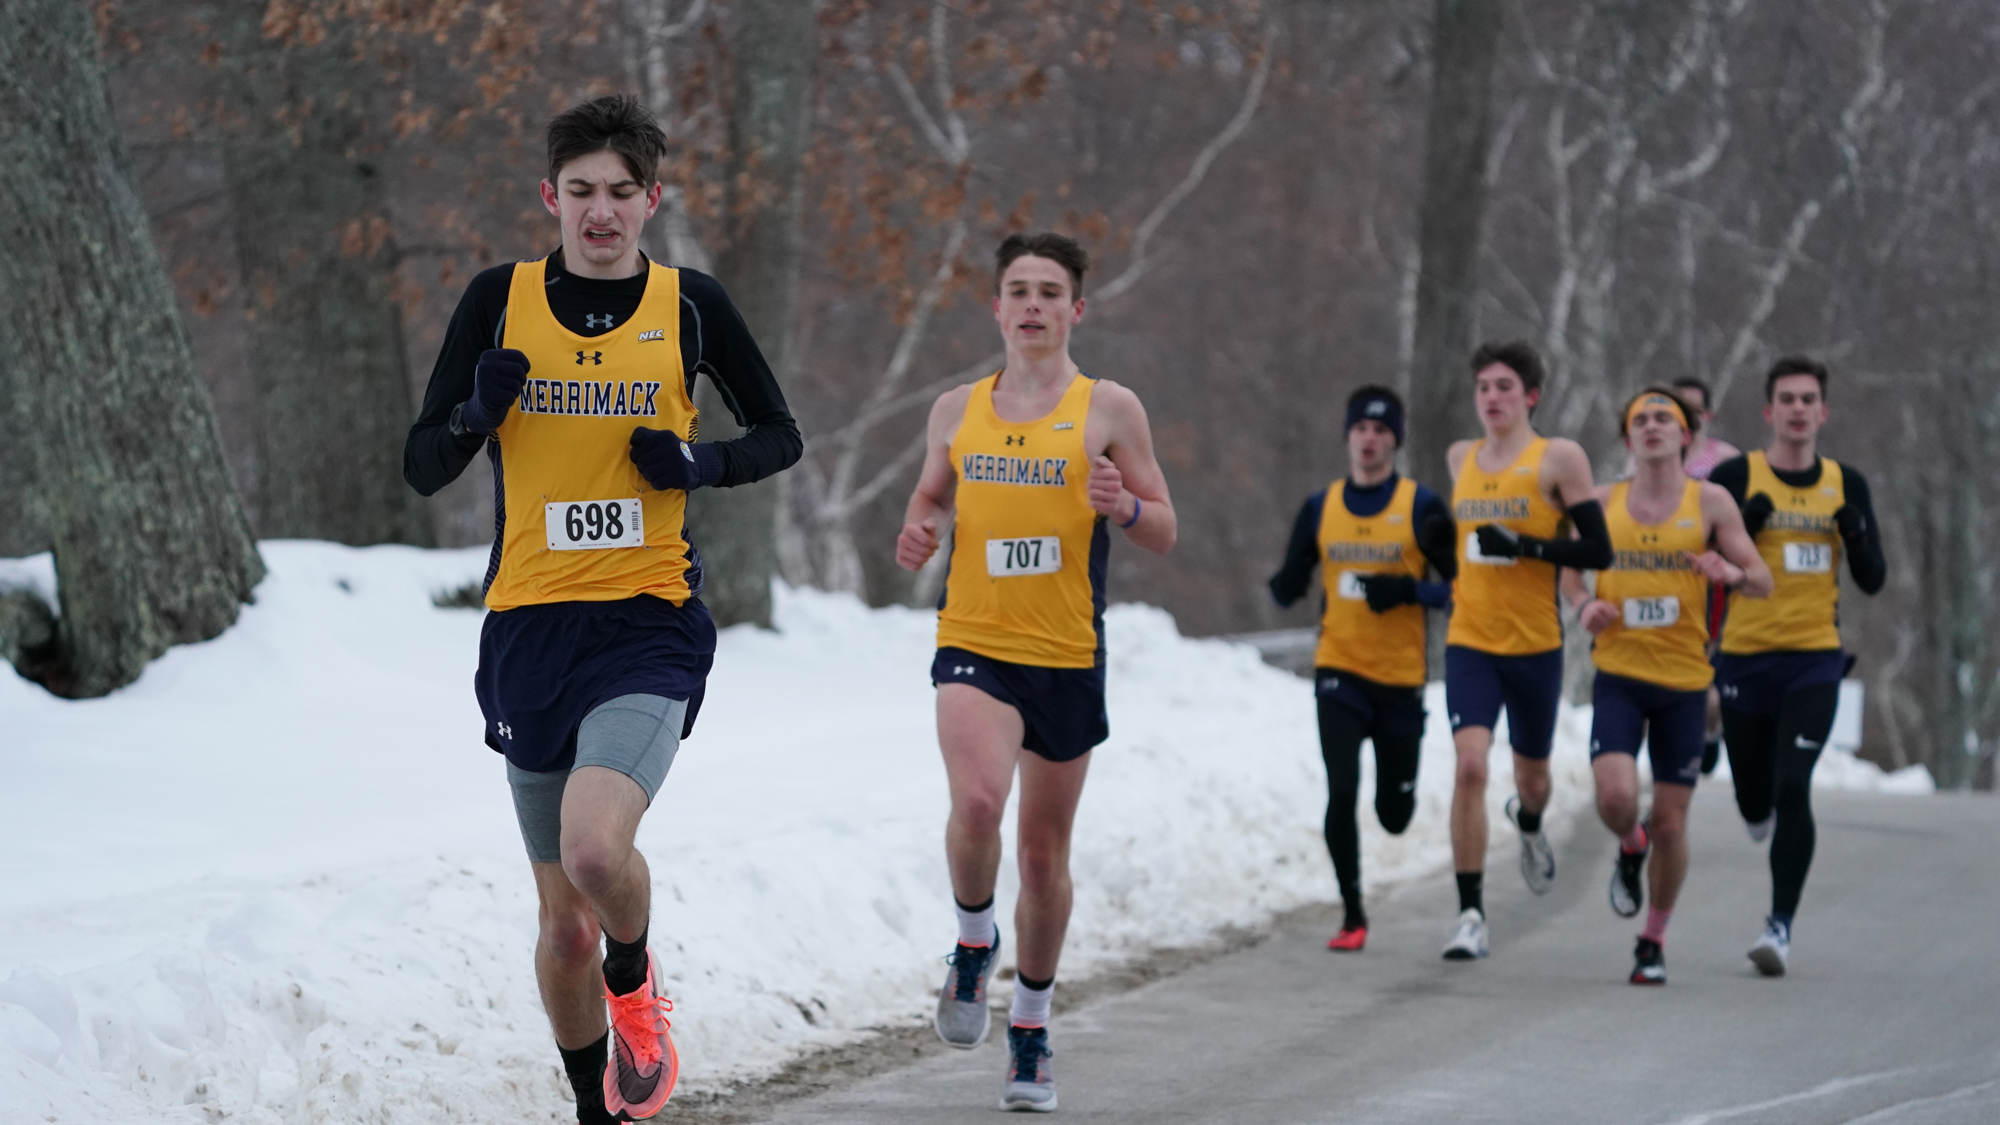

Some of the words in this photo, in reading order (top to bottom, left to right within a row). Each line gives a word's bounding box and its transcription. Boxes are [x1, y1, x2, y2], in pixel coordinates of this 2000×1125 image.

[638, 329, 664, 341] NEC
[520, 378, 661, 418] MERRIMACK
[963, 453, 1068, 486] MERRIMACK
[565, 502, 624, 542] 698
[1002, 539, 1042, 569] 707
[1798, 544, 1820, 567] 713
[1638, 600, 1665, 620] 715
